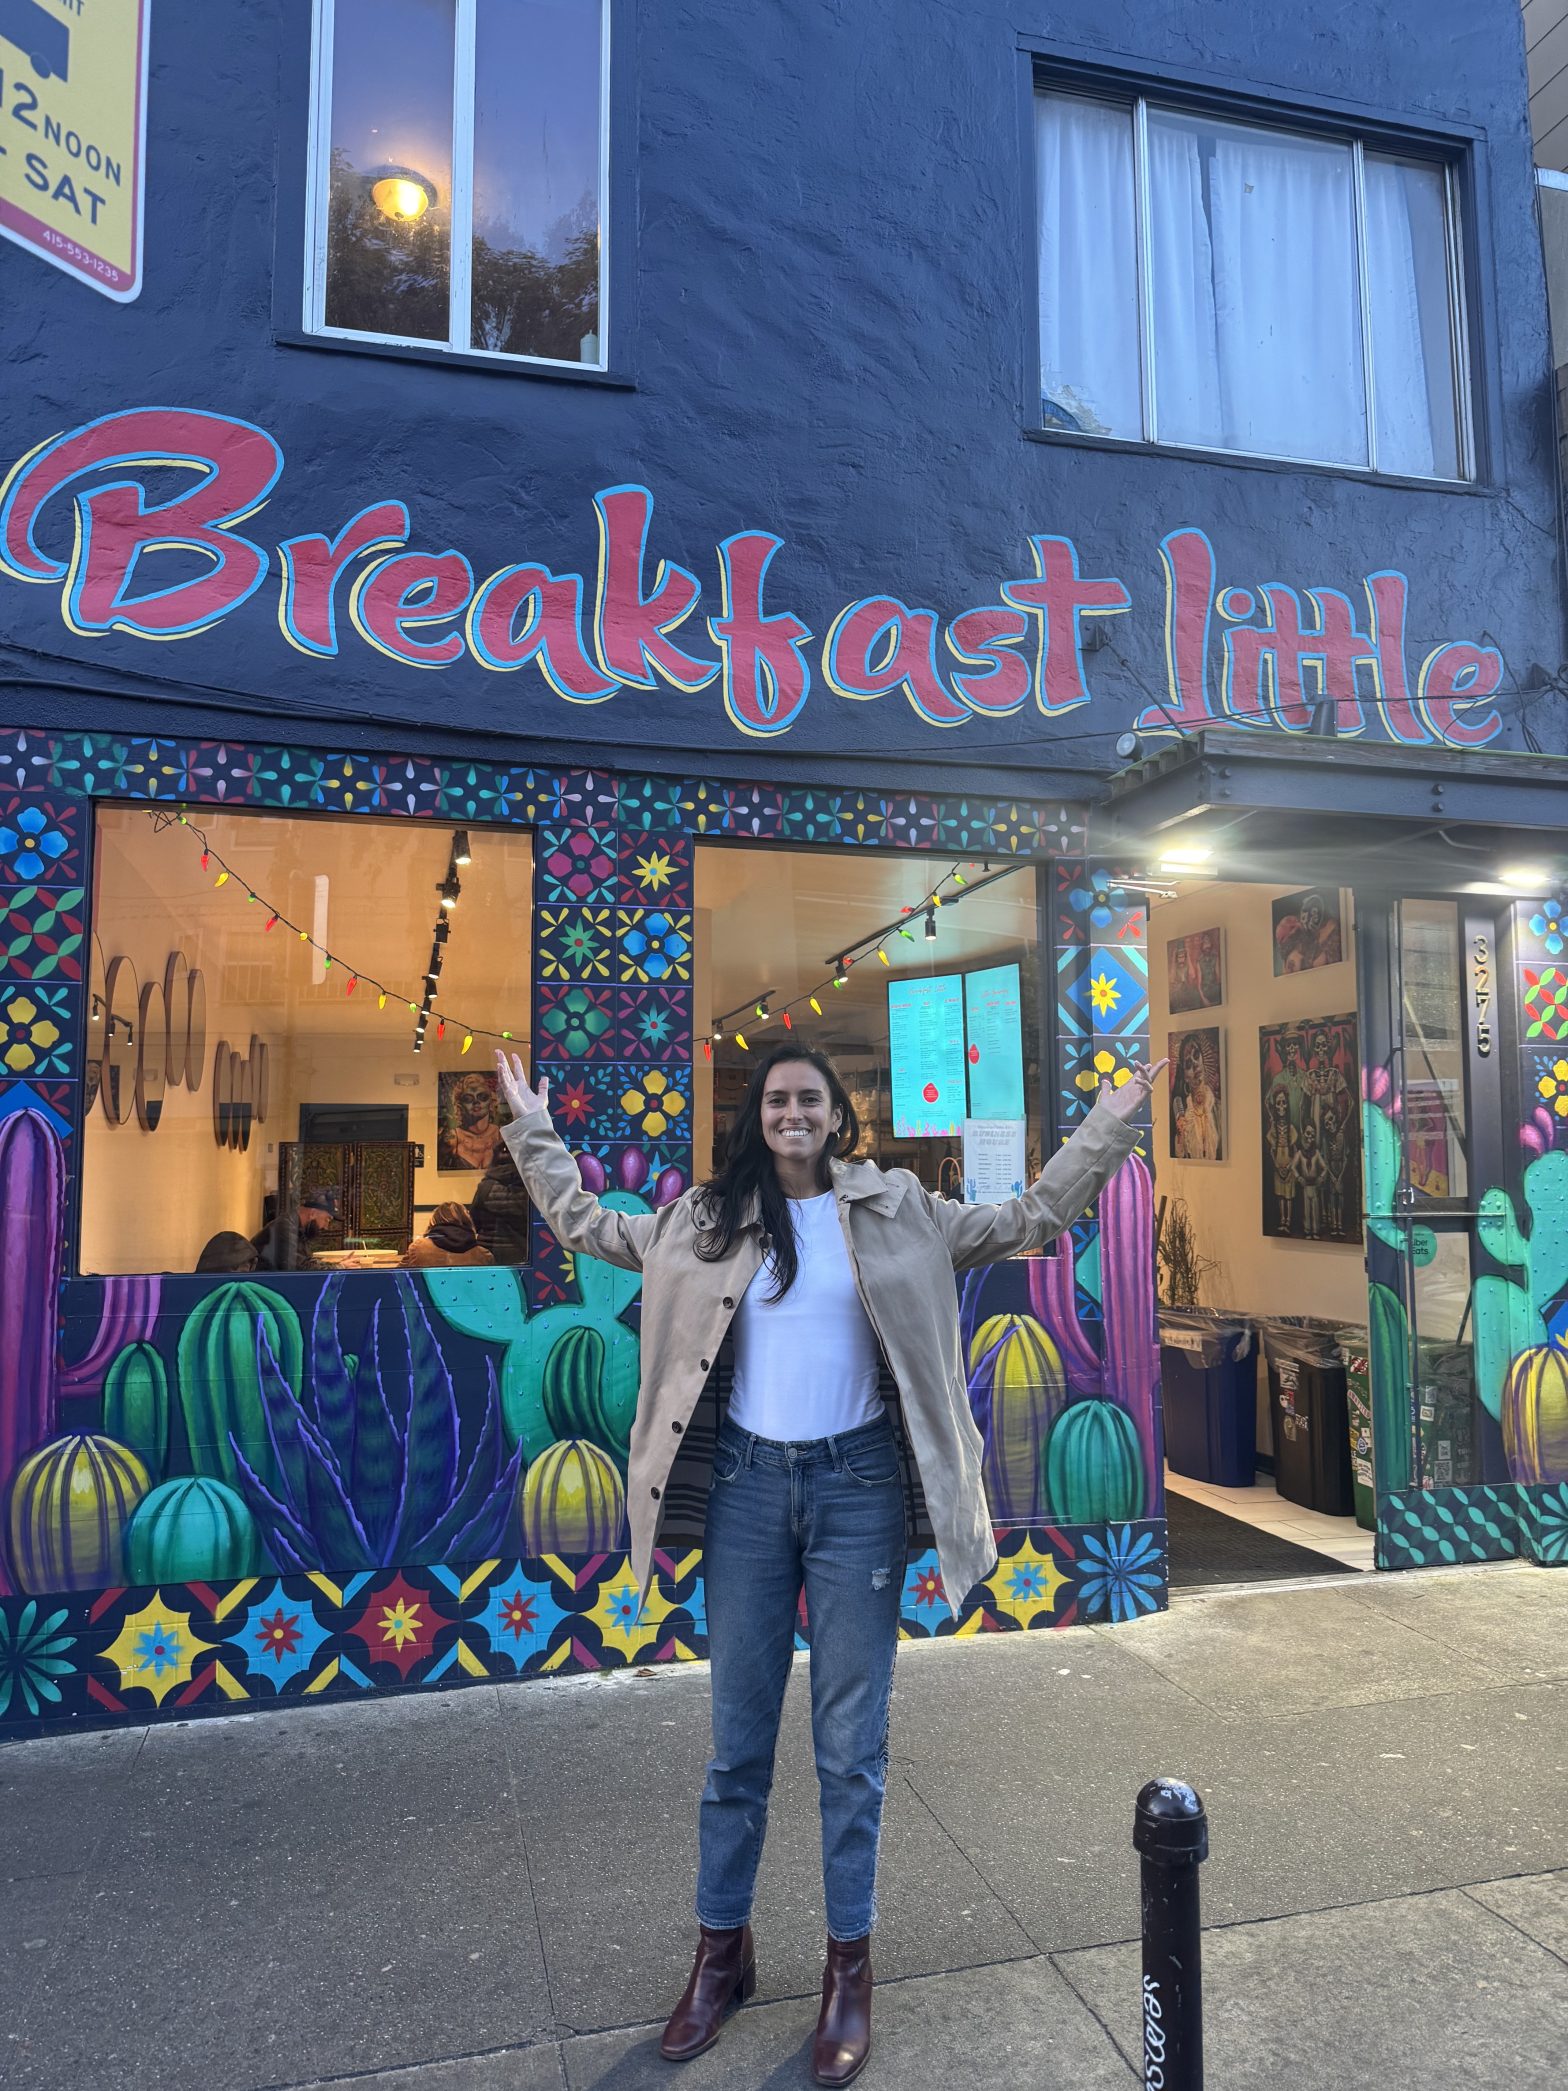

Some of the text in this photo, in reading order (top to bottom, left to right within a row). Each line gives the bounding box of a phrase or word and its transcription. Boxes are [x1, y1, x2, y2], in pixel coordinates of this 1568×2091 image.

[44, 113, 121, 187] NOON
[24, 152, 106, 226] SAT
[43, 229, 119, 282] 415-553-1235
[0, 406, 1132, 737] Breakfast
[1473, 934, 1492, 1056] 3275
